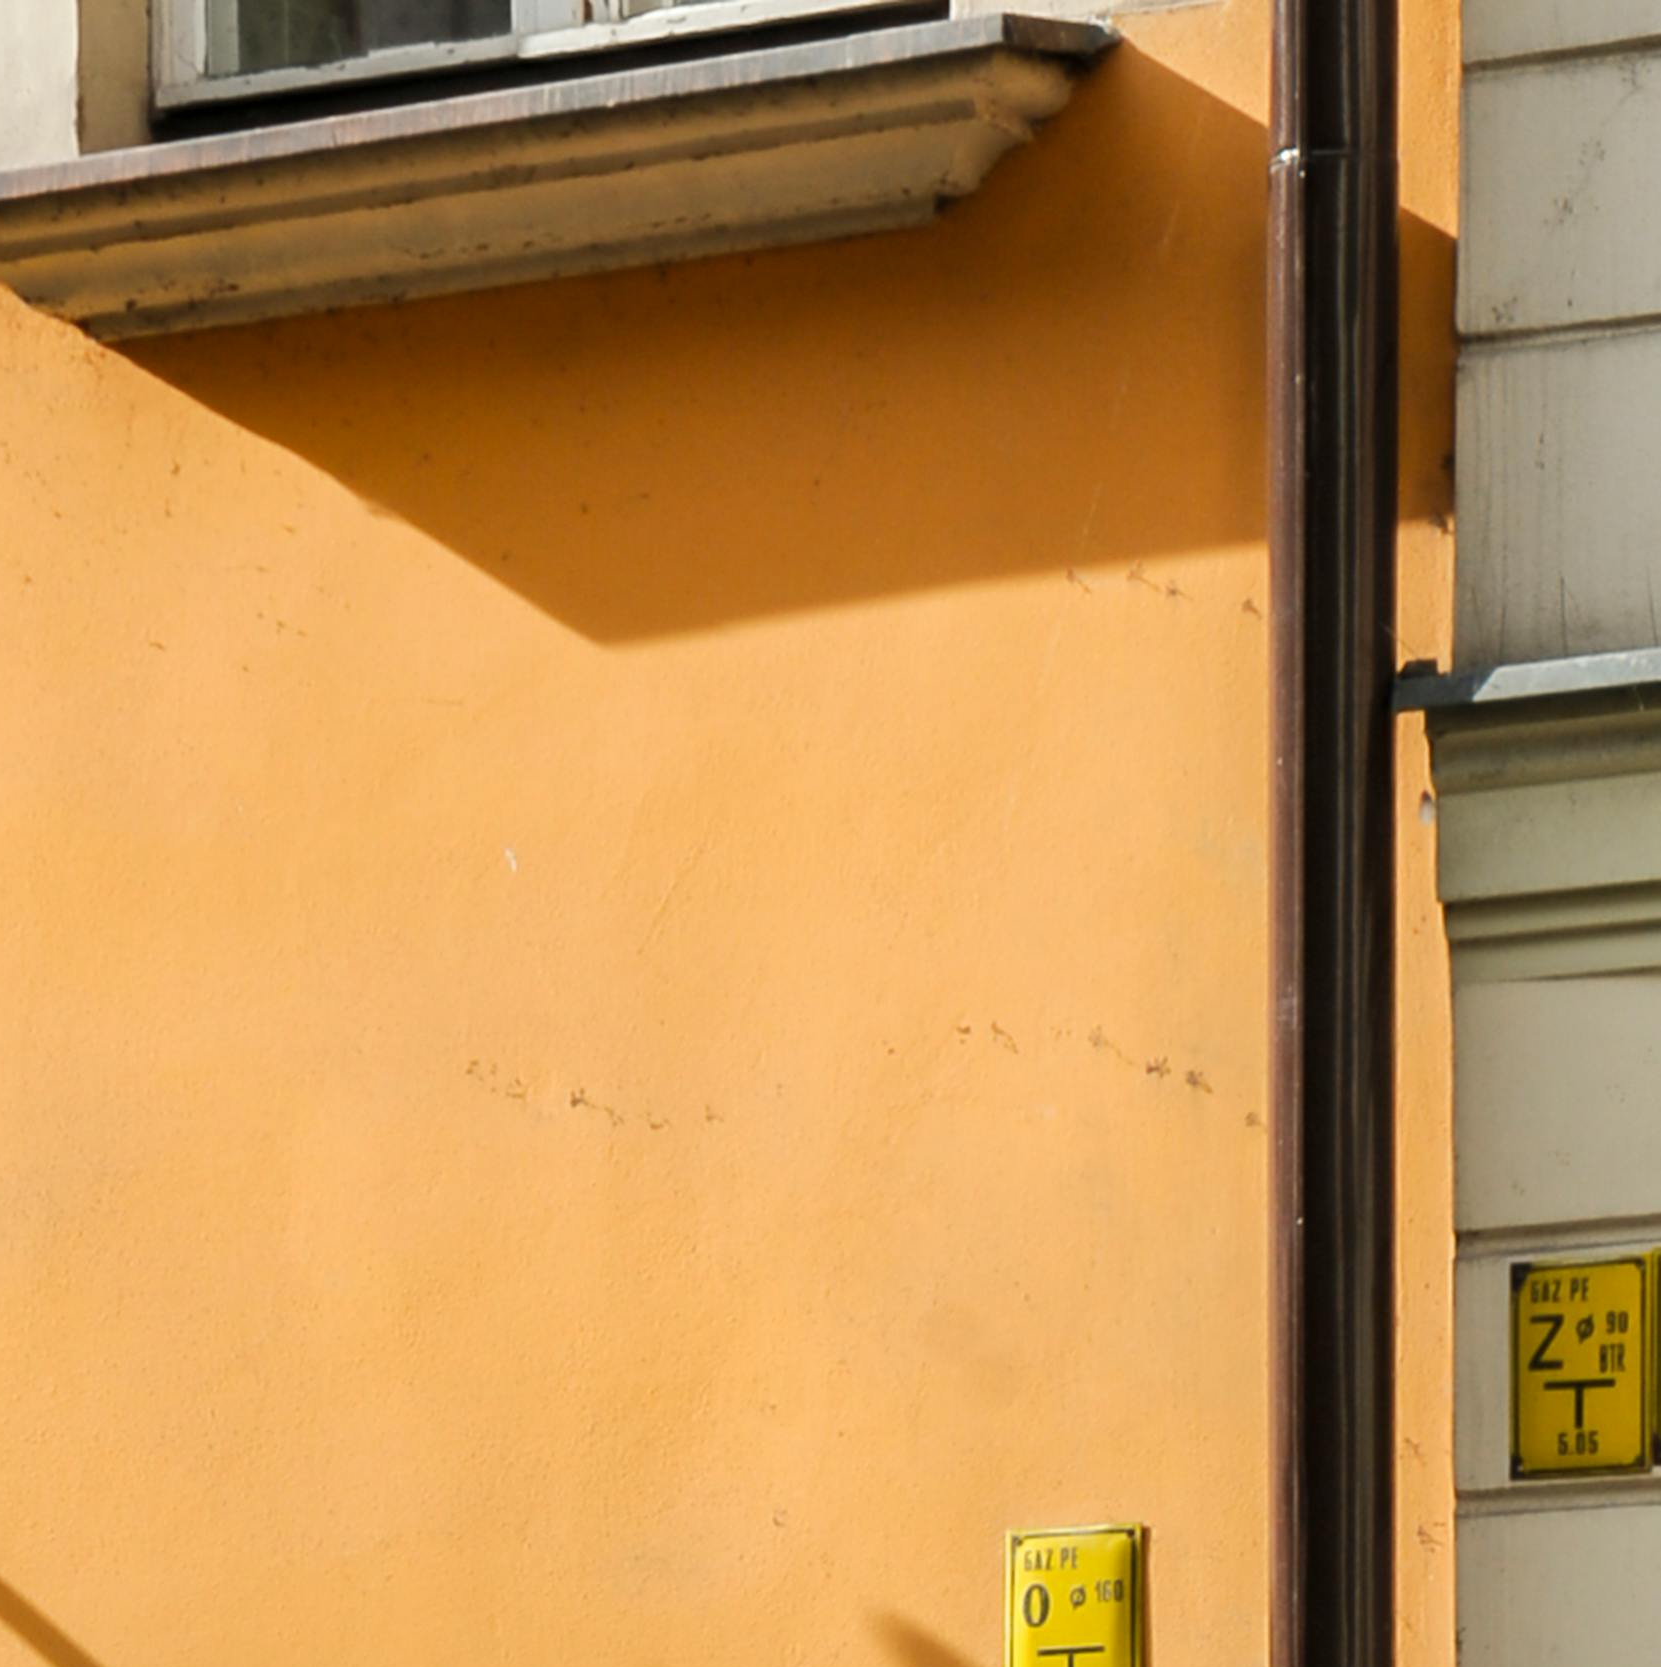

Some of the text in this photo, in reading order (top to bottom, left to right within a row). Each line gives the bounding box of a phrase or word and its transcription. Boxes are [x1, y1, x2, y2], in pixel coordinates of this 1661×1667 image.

[1530, 1277, 1589, 1303] GAZ PE
[1528, 1313, 1565, 1371] Z
[1606, 1310, 1629, 1334] 90
[1024, 1547, 1078, 1572] GAZ PE
